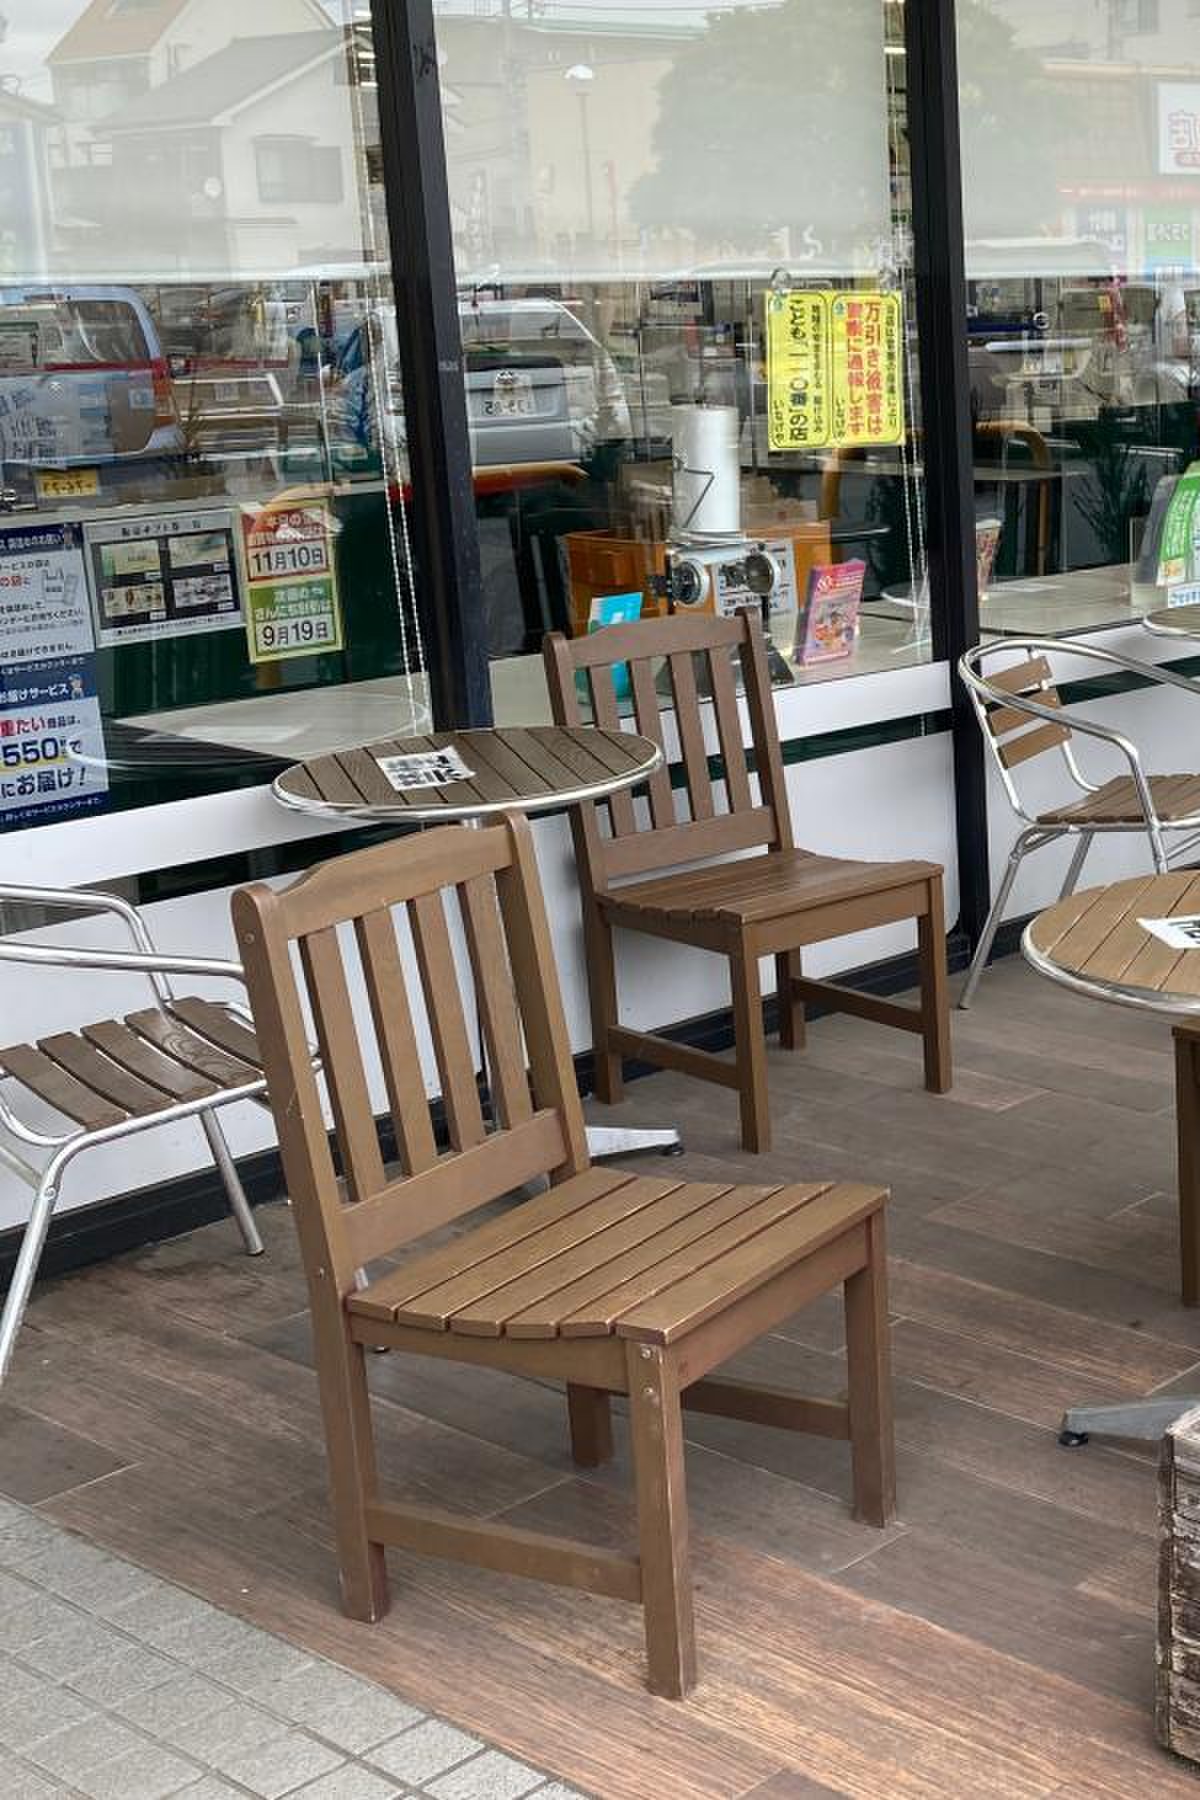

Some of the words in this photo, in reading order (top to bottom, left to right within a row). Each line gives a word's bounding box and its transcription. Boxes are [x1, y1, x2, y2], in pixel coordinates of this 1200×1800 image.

[865, 302, 882, 436] 万引き被害は
[252, 546, 323, 573] 11月10日
[262, 620, 328, 647] 9月19日
[1, 767, 86, 798] にお届け!
